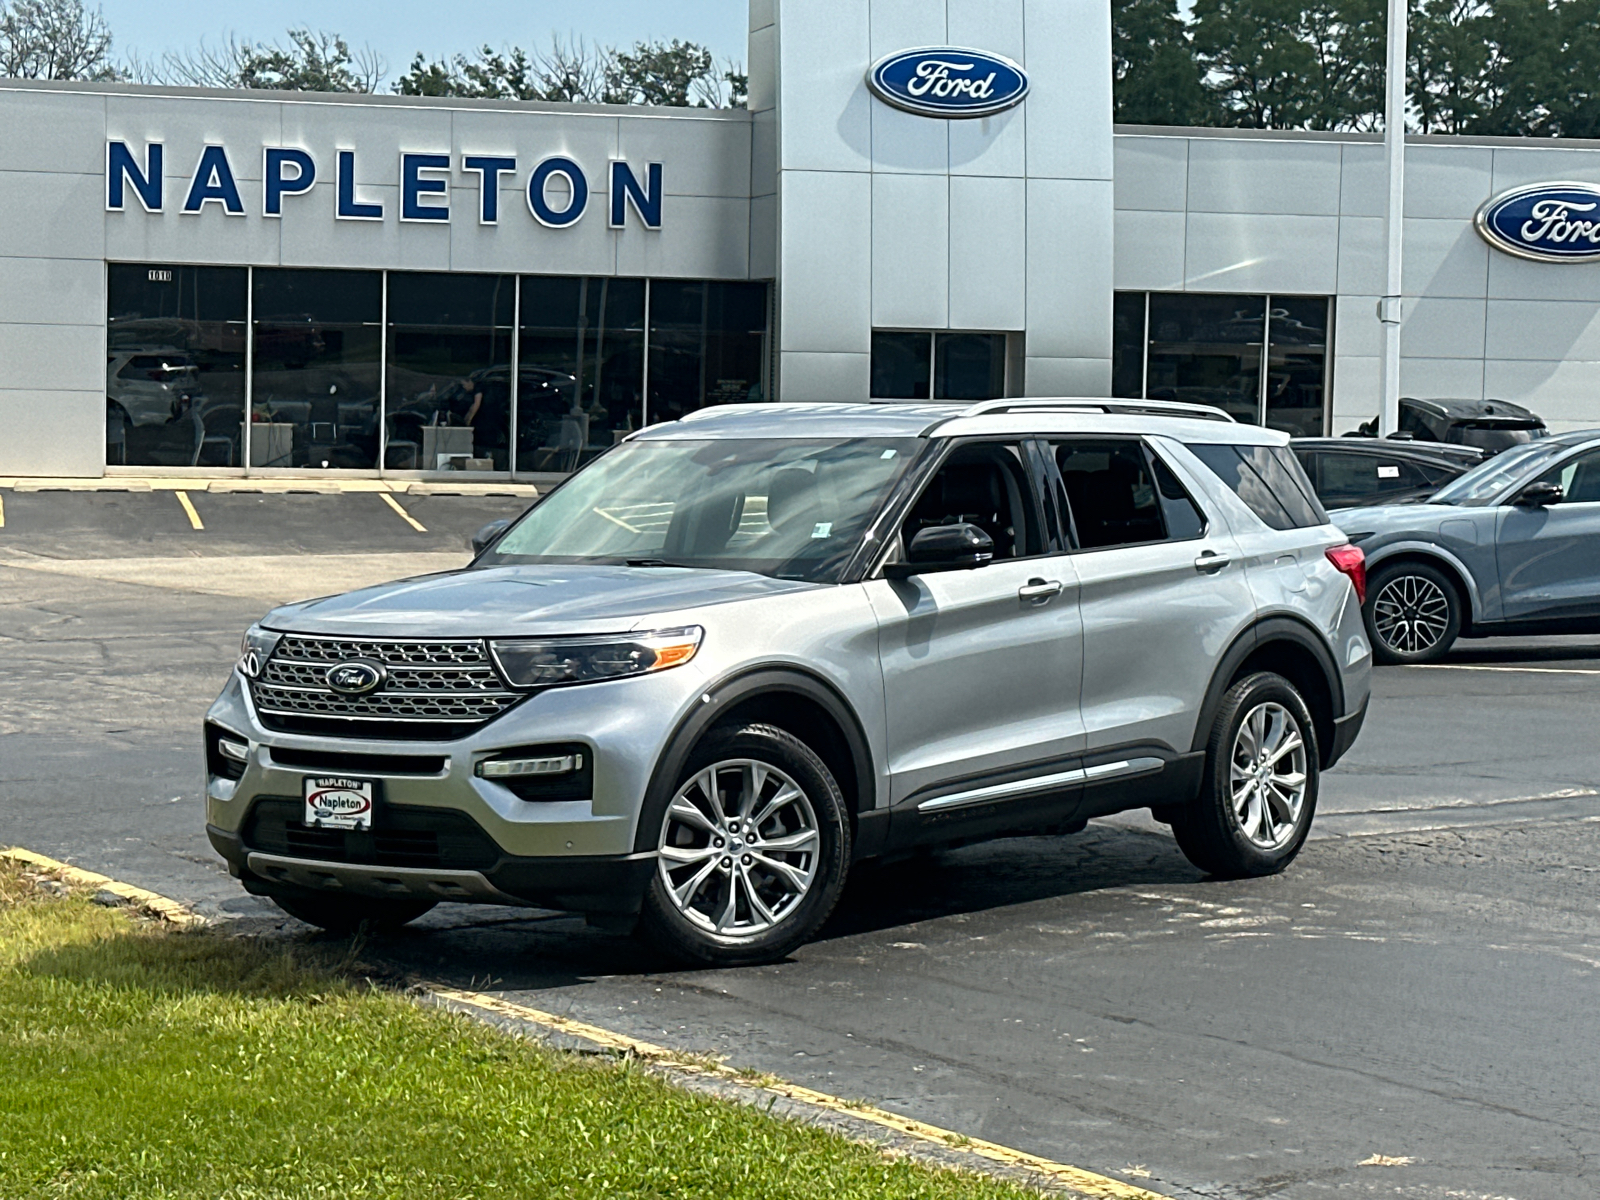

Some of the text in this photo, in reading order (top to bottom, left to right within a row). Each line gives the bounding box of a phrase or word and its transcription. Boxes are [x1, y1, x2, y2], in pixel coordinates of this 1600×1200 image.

[907, 60, 997, 99] Ford
[105, 139, 664, 231] NAPLETON
[149, 270, 171, 281] 1010
[335, 668, 365, 685] Ford
[319, 778, 359, 788] NAPLETON
[320, 795, 361, 810] Napleton
